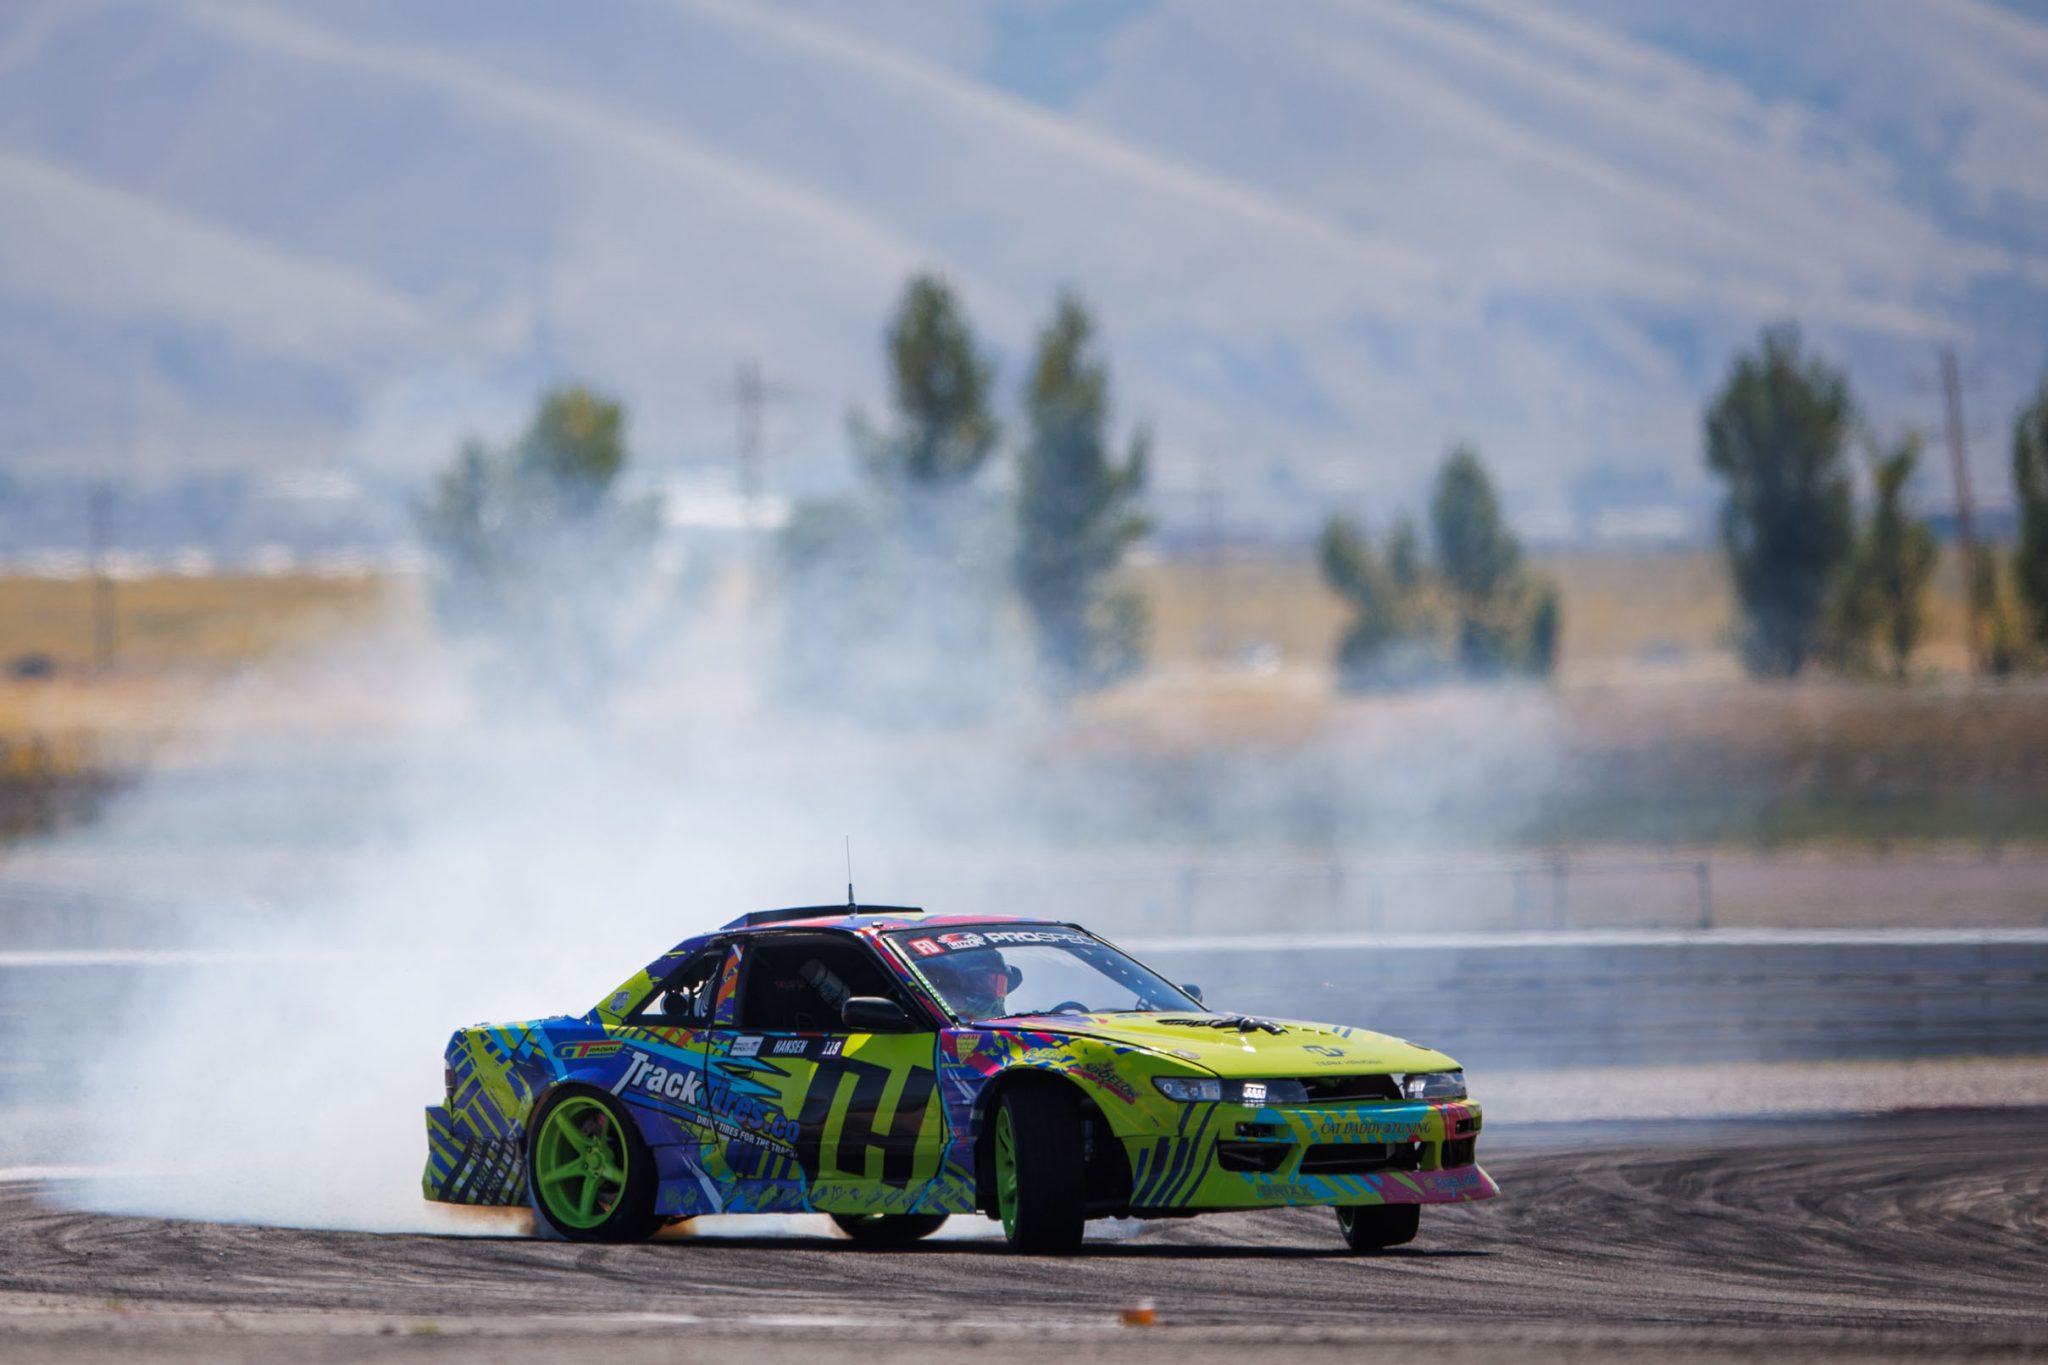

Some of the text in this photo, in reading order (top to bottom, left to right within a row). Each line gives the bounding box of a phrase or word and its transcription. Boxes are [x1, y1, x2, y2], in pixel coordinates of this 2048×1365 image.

[773, 1040, 808, 1054] HANSEN
[1320, 1121, 1432, 1134] CAT DADDY TUNING
